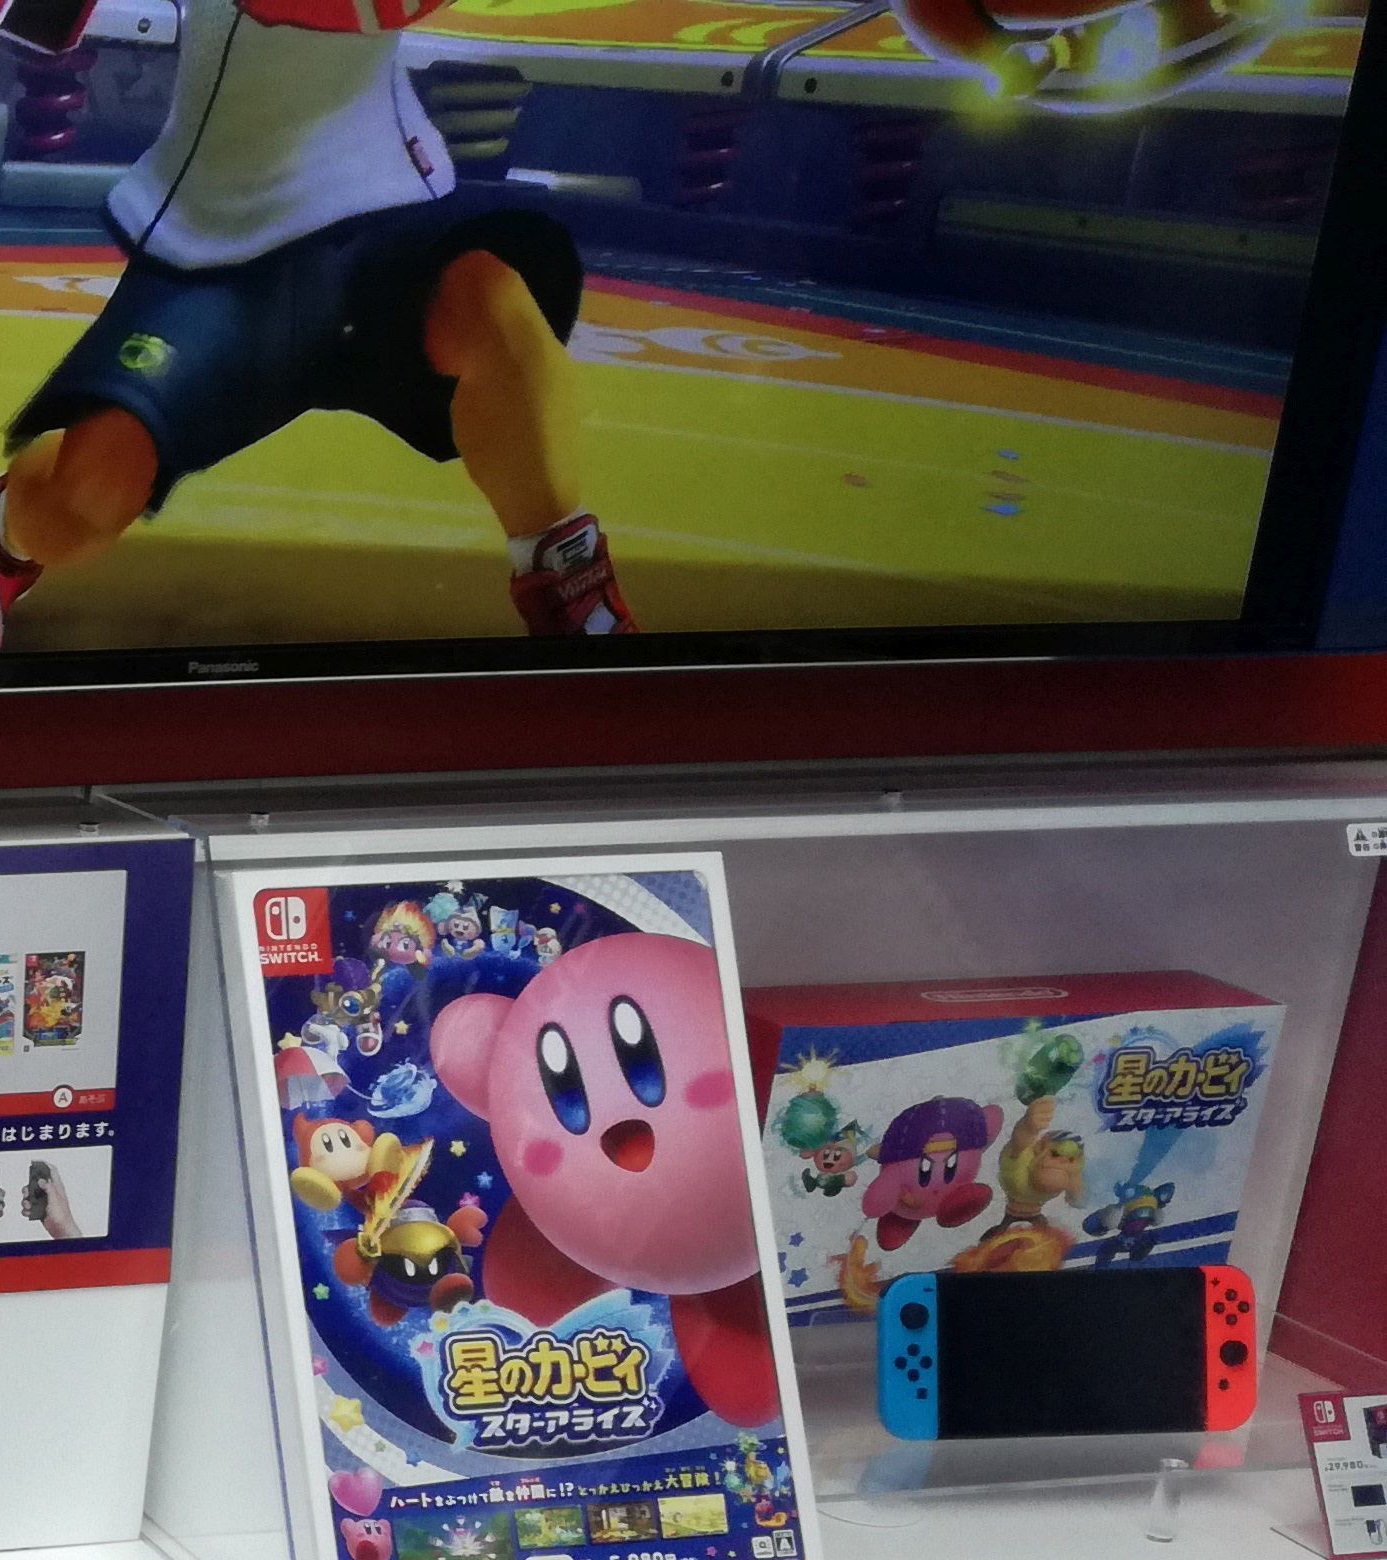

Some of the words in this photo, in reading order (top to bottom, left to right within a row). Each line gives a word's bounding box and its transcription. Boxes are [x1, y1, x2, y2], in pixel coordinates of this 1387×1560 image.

[188, 661, 259, 674] Panasonic
[260, 951, 321, 964] SWITCH
[1108, 1054, 1247, 1102] 星のカービィ
[1117, 1103, 1236, 1126] スターアライズ
[447, 1340, 645, 1407] 星のカービィ
[481, 1405, 648, 1439] スターアライズ
